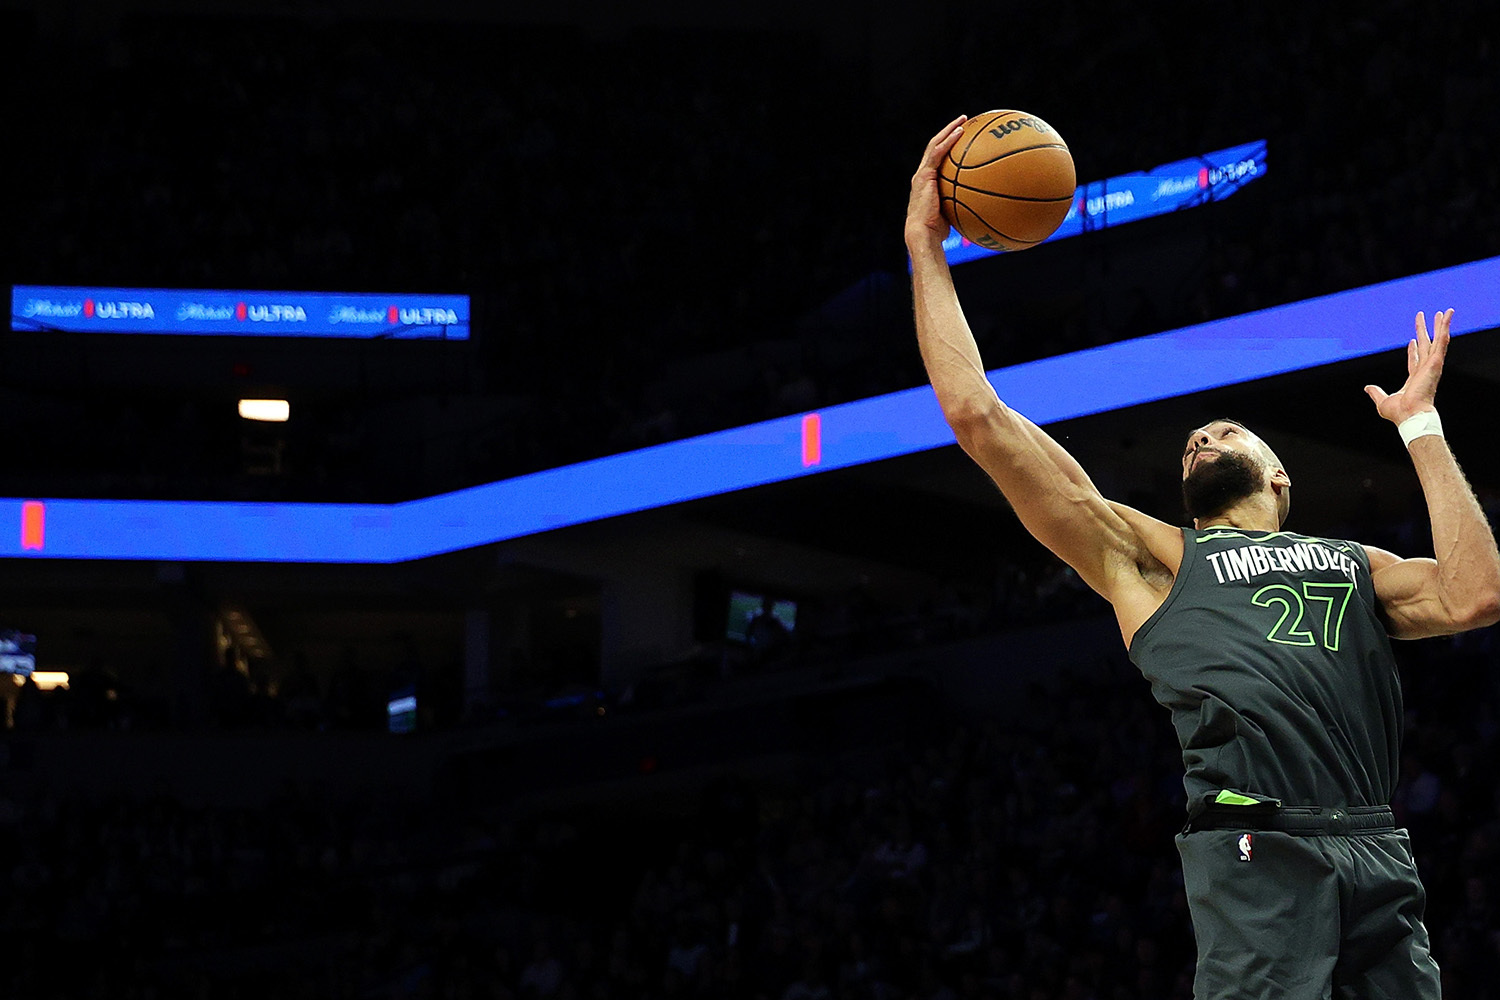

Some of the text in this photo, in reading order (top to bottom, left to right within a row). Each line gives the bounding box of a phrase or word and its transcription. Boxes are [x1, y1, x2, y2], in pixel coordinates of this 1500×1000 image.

[95, 301, 155, 319] ULTRA
[248, 304, 307, 322] ULTRA
[399, 307, 458, 325] ULTRA
[1251, 582, 1354, 652] 27
